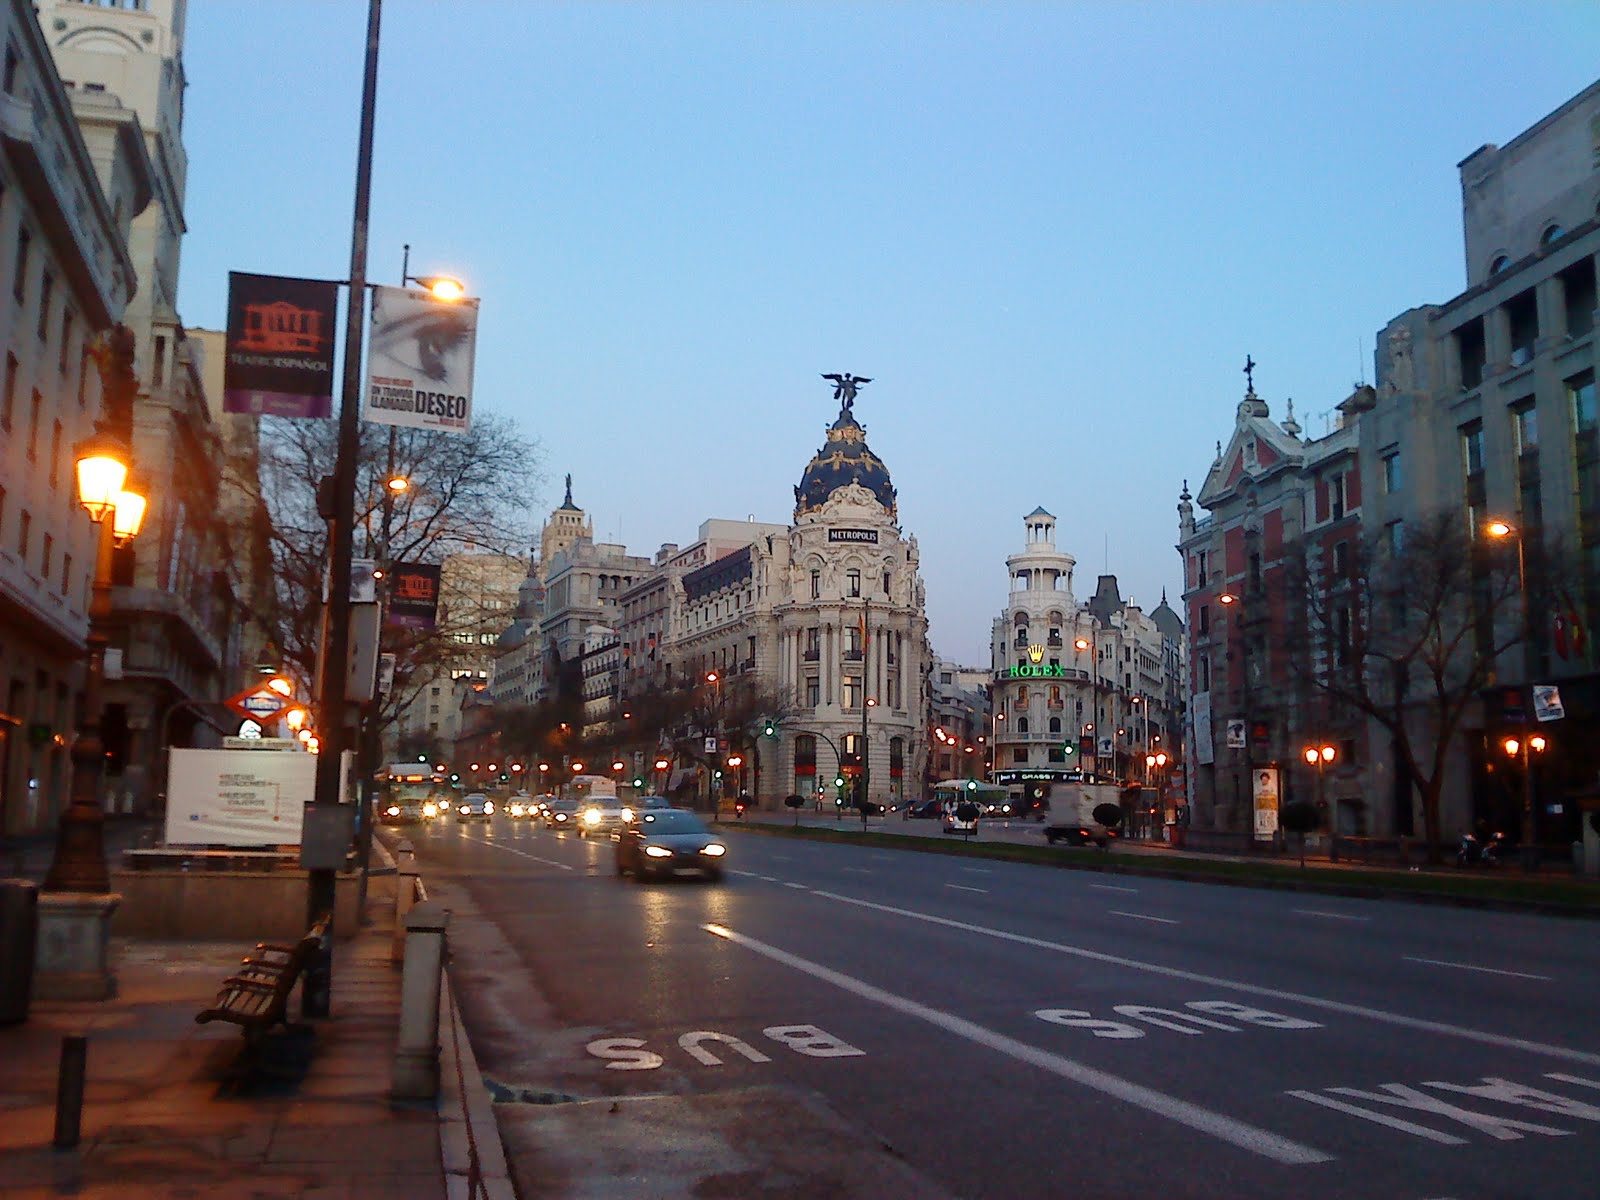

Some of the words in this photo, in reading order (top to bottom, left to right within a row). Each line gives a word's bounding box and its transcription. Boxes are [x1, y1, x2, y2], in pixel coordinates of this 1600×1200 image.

[415, 390, 466, 419] DESEO
[831, 531, 876, 541] METROPOLIS
[1010, 663, 1064, 678] ROLEX
[246, 699, 280, 709] Metro
[1034, 1001, 1325, 1039] BUS
[586, 1024, 867, 1071] BUS
